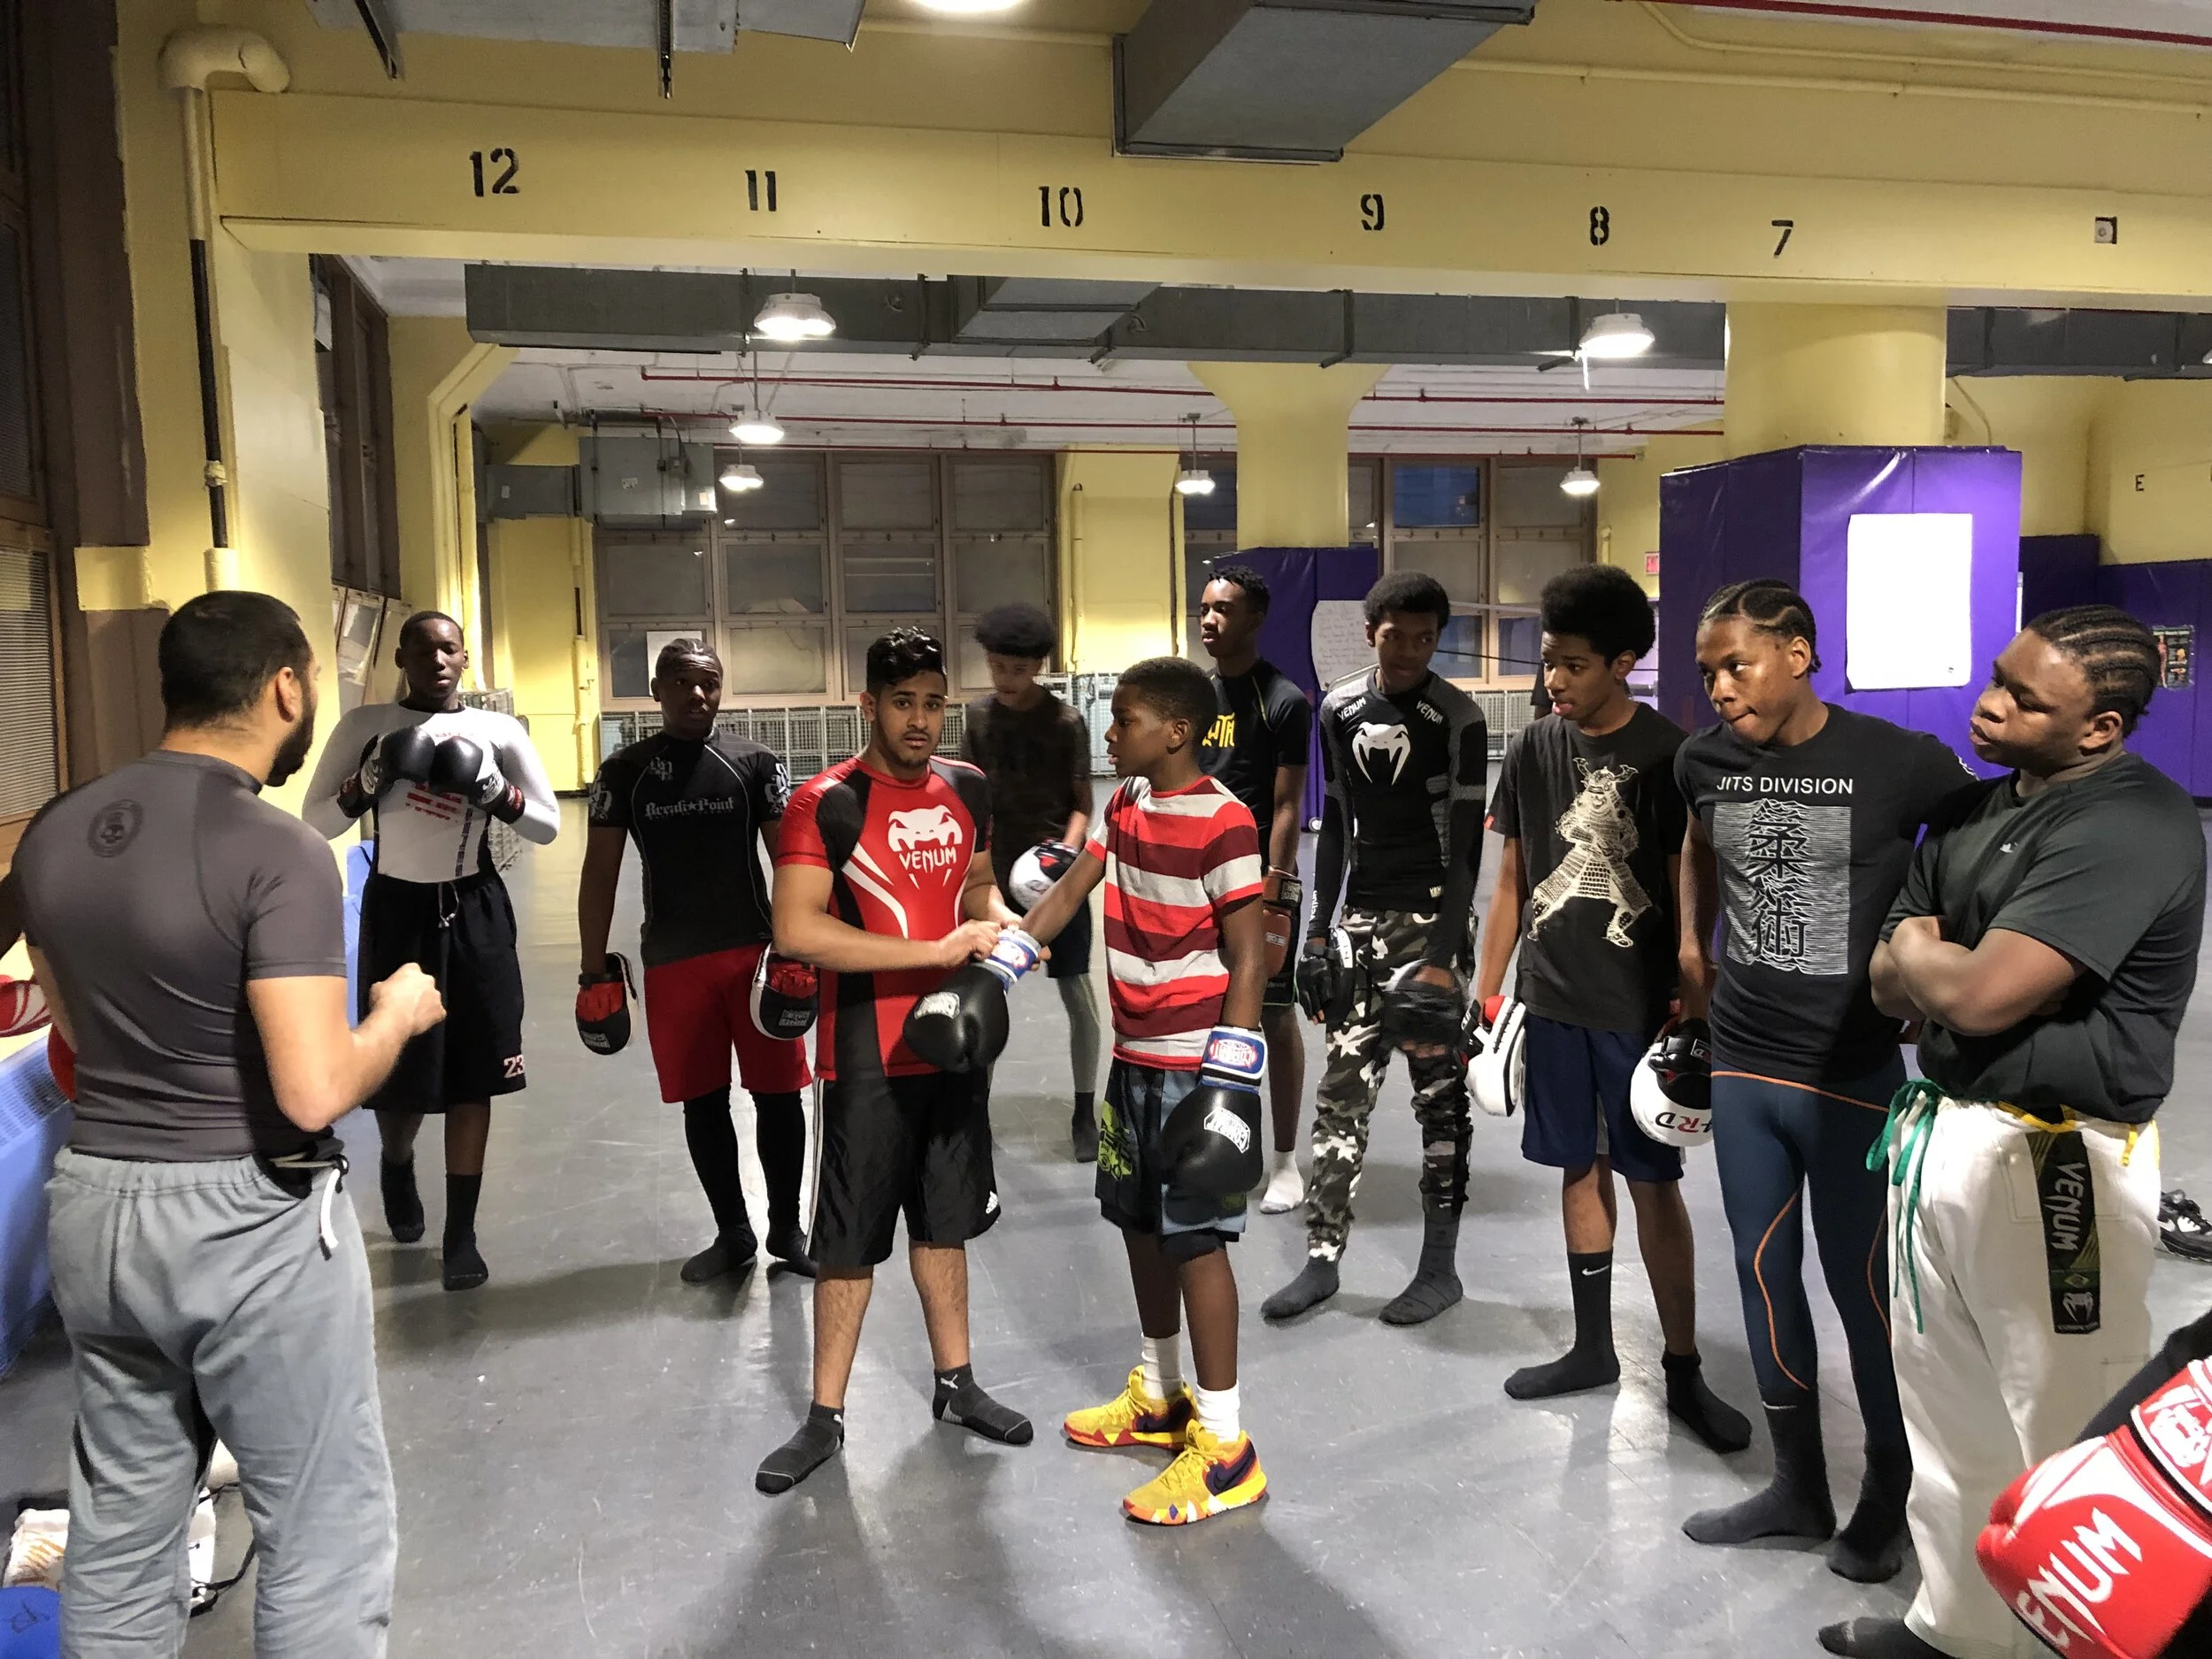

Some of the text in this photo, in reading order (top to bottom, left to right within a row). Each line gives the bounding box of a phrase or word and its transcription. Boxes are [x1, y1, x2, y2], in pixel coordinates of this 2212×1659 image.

[469, 148, 519, 197] 12
[745, 169, 777, 211] 11
[1038, 186, 1084, 227] 10
[1360, 194, 1385, 231] 9
[1590, 205, 1609, 246] 8
[1771, 219, 1794, 258] 7
[2135, 474, 2145, 491] E
[1337, 696, 1367, 721] VENUM
[1416, 700, 1444, 726] VENUM
[1717, 776, 1854, 795] JITS DIVISION
[898, 845, 957, 874] VENUM
[503, 1054, 524, 1079] 23
[2042, 1161, 2087, 1252] VENUM
